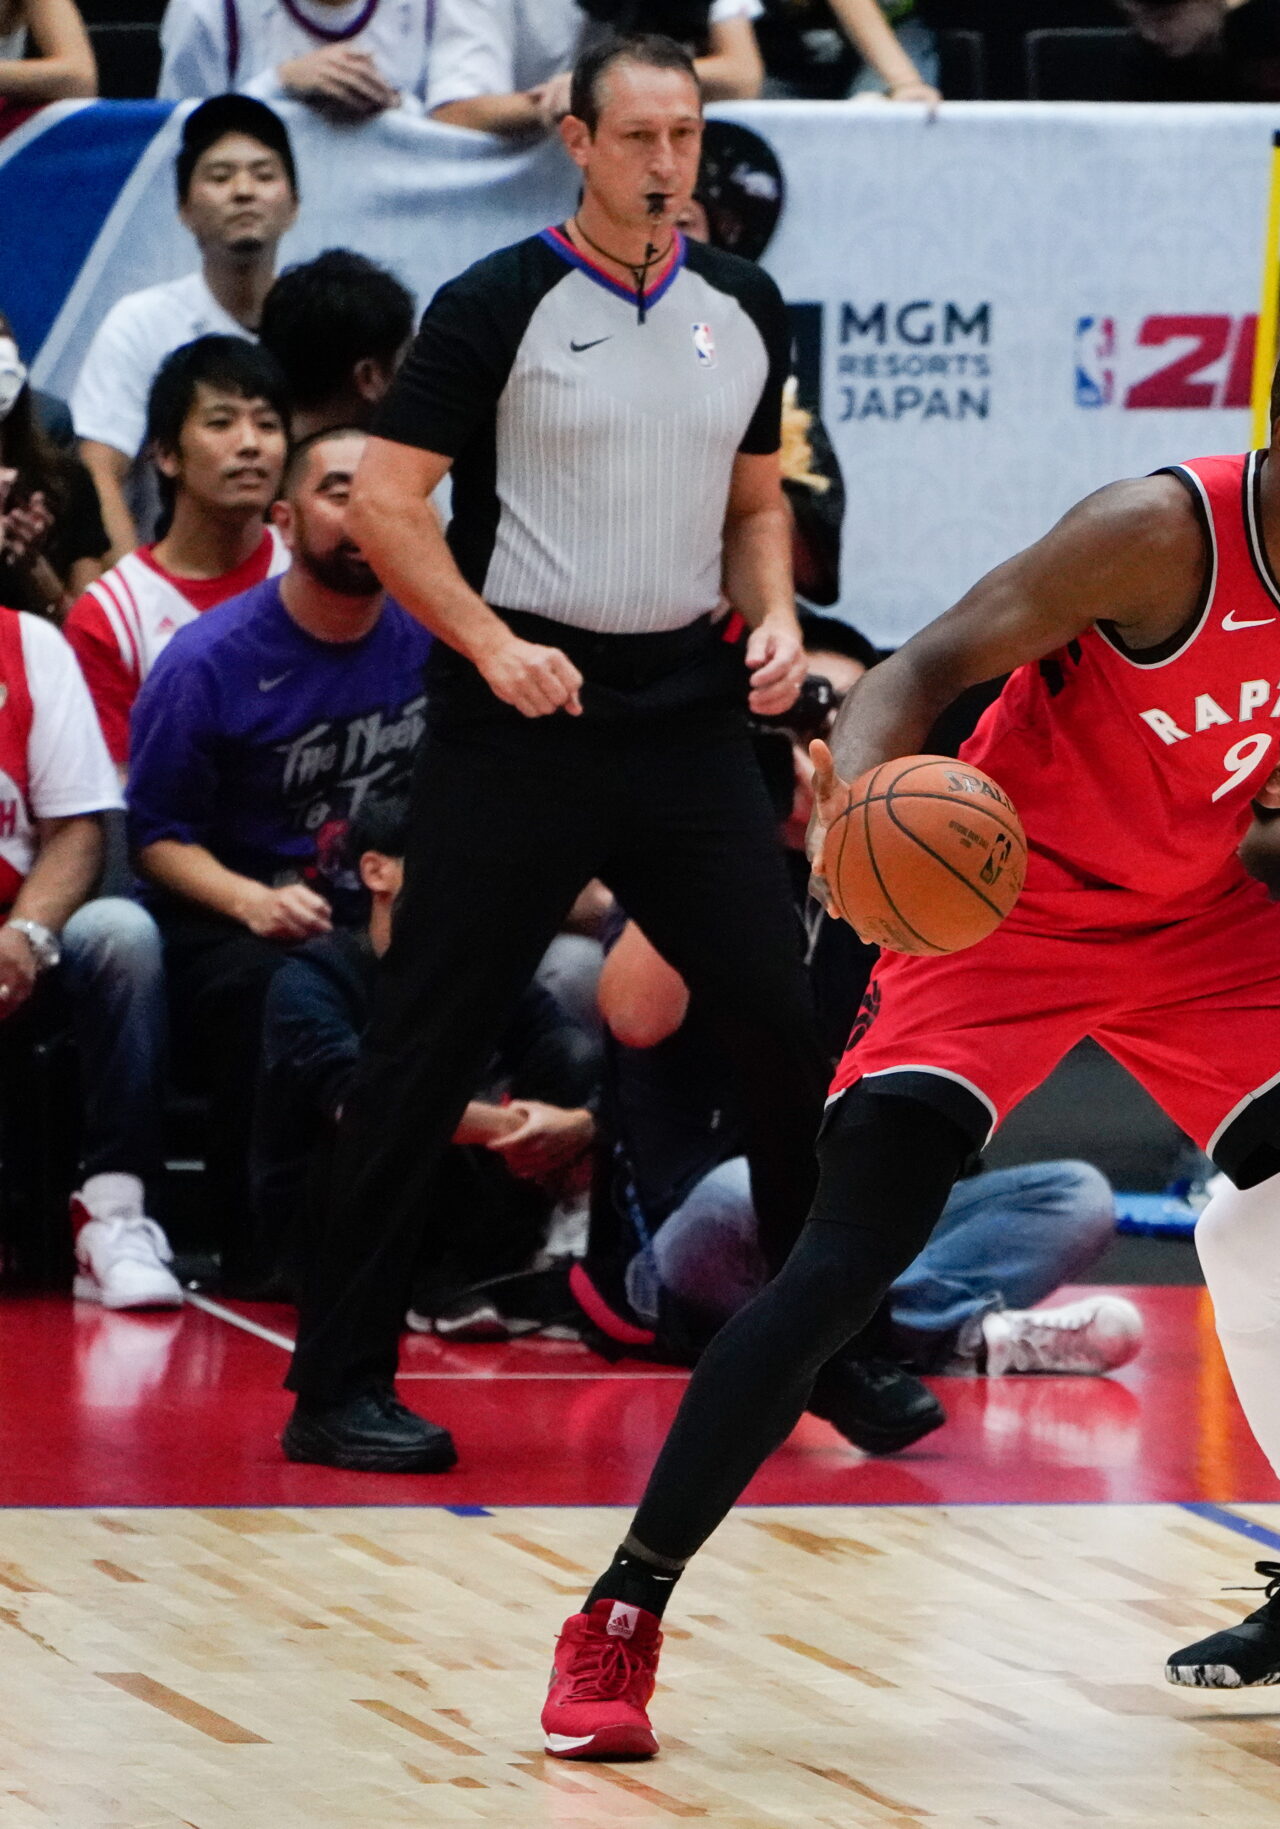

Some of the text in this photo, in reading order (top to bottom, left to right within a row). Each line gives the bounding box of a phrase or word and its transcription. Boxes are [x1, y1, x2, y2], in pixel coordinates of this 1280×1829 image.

[839, 301, 990, 346] MGM
[838, 354, 990, 377] RESORTS
[838, 384, 990, 422] JAPAN
[1212, 732, 1273, 803] 9
